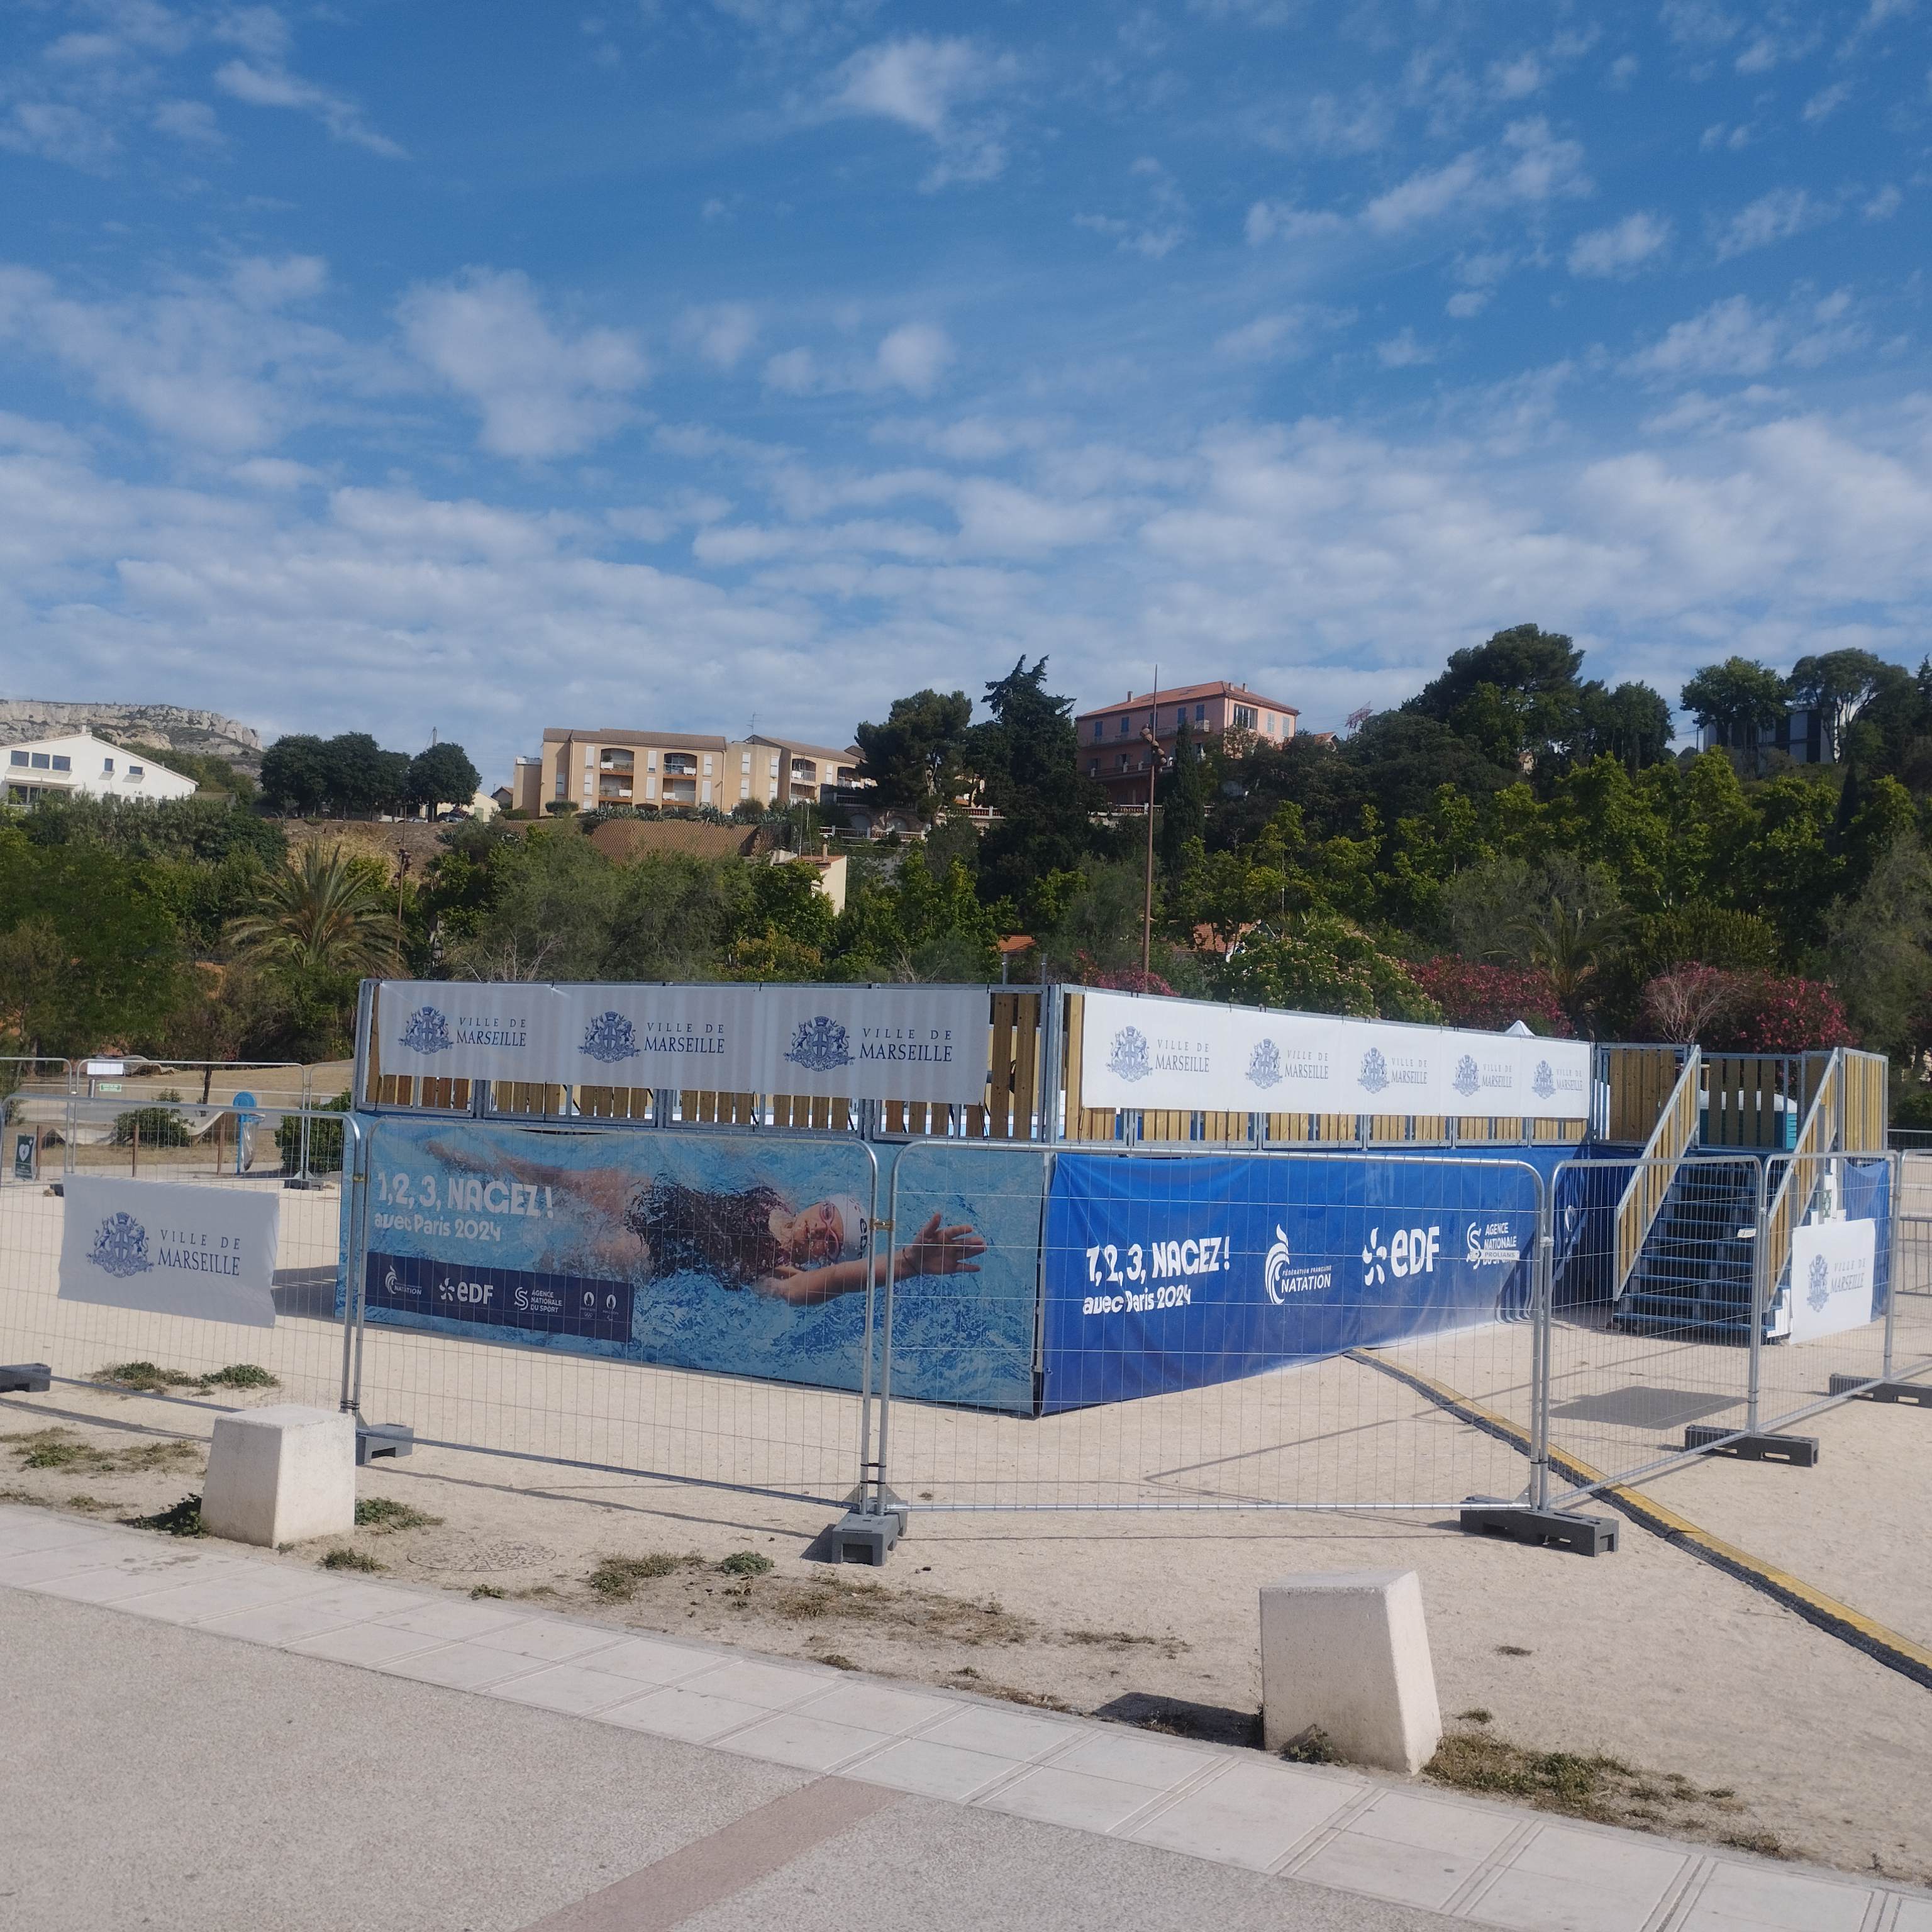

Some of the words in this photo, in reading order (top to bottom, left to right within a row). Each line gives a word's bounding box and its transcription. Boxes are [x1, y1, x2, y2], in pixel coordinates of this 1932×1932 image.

[459, 1017, 499, 1026] VILLE
[510, 1019, 526, 1028] DE
[647, 1023, 692, 1032] VILLE
[706, 1024, 724, 1033] DE
[457, 1030, 526, 1046] MARSEILLE
[863, 1028, 915, 1038] VILLE
[931, 1030, 952, 1040] DE
[644, 1036, 724, 1053] MARSEILLE
[1157, 1039, 1189, 1051] VILLE
[1197, 1043, 1209, 1052] DE
[860, 1043, 952, 1062] MARSEILLE
[1287, 1050, 1312, 1060] VILLE
[1318, 1052, 1328, 1061] DE
[1155, 1054, 1209, 1072] MARSEILLE
[1392, 1057, 1413, 1067] VILLE
[1284, 1063, 1329, 1079] MARSEILLE
[1391, 1070, 1428, 1084] MARSEILLE
[374, 1213, 413, 1231] avec
[414, 1214, 452, 1237] Paris
[455, 1218, 501, 1241] 2024
[1485, 1222, 1509, 1236] AGENCE
[161, 1230, 206, 1246] VILLE
[221, 1236, 240, 1250] DE
[1484, 1236, 1517, 1250] NATIONALE
[158, 1247, 240, 1275] MARSEILLE
[394, 1285, 422, 1295] NATATION
[1281, 1274, 1331, 1293] NATATION
[531, 1289, 554, 1298] AGENCE
[1083, 1295, 1124, 1315] avec
[1125, 1287, 1155, 1313] Paris
[1157, 1284, 1192, 1309] 2024
[531, 1297, 564, 1306] NATIONALE
[540, 1305, 559, 1313] SPORT
